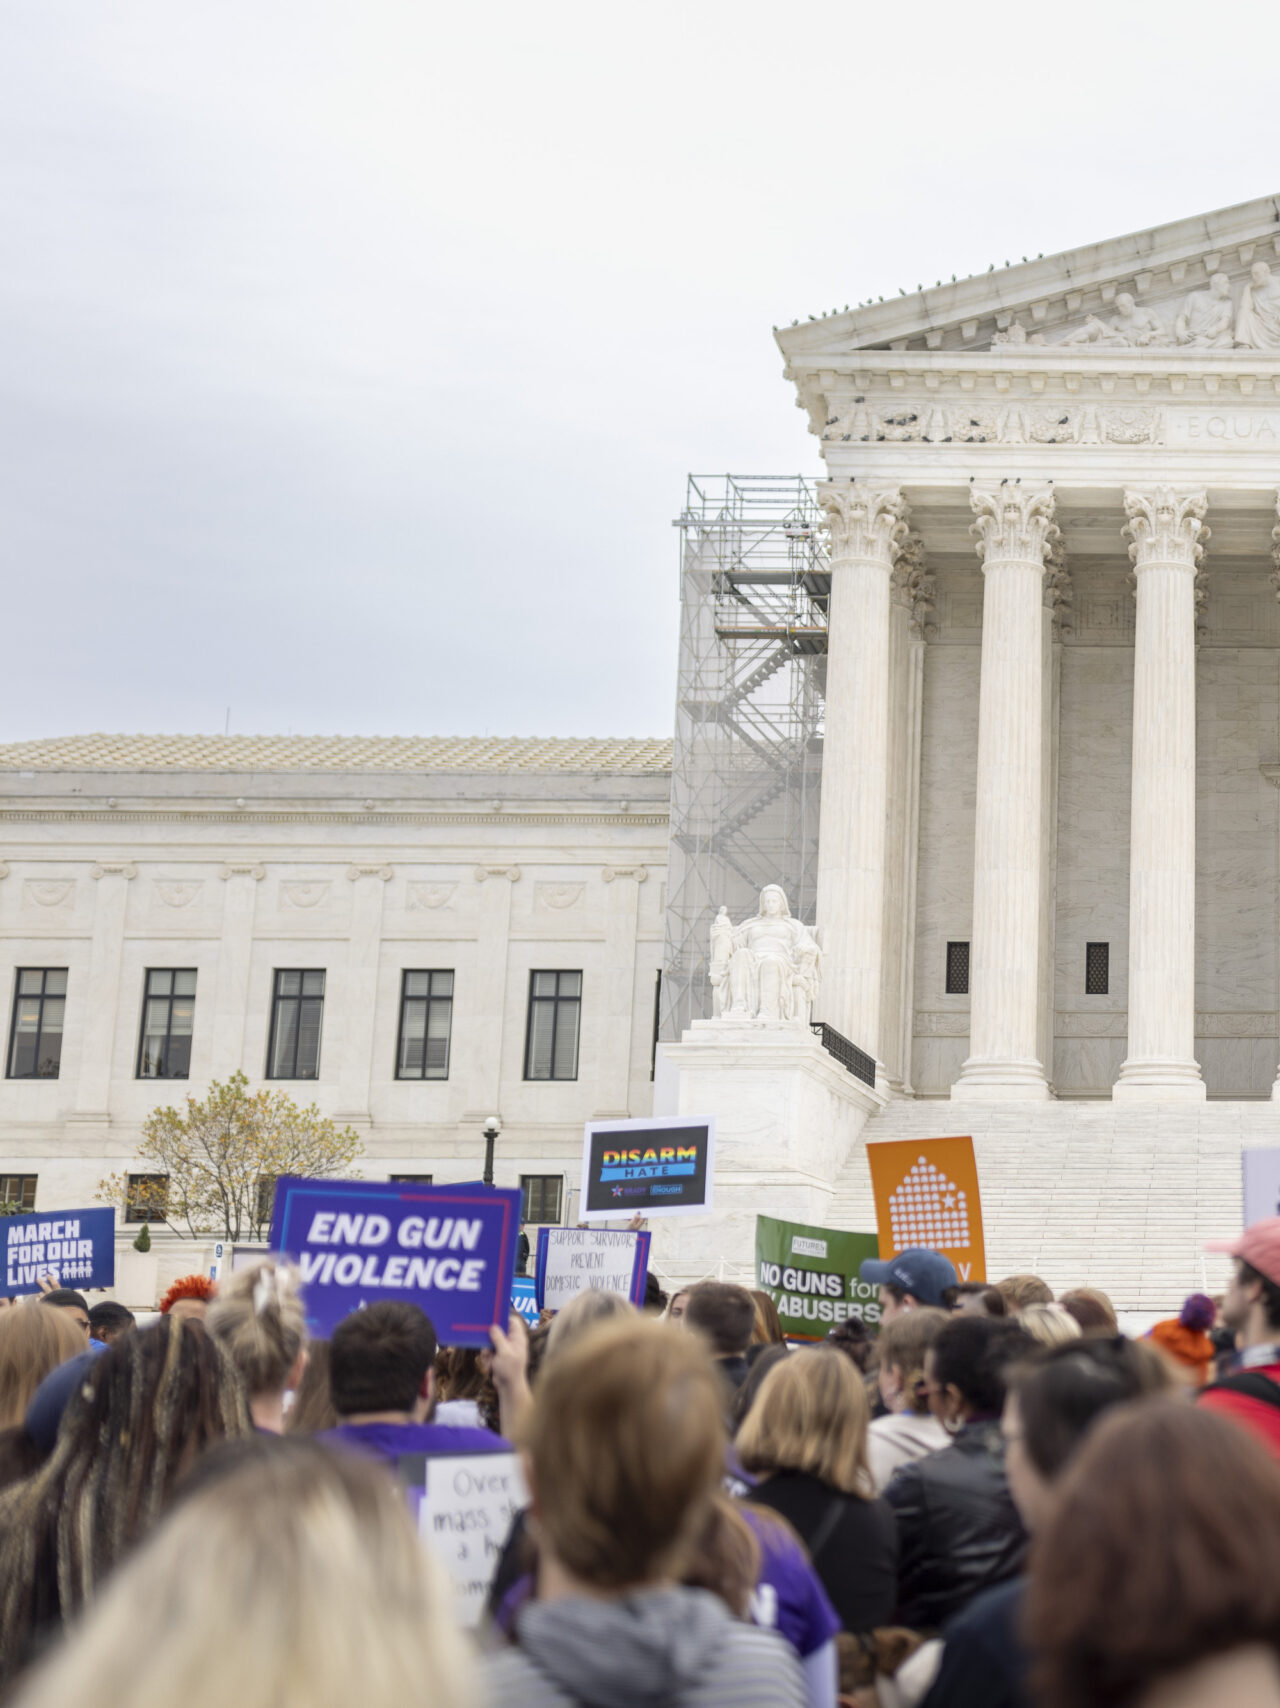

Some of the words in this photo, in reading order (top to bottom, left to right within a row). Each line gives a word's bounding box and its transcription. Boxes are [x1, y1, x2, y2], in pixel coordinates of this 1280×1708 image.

[603, 1146, 697, 1168] DISARM
[625, 1166, 669, 1178] HATE
[8, 1219, 80, 1245] MARCH
[306, 1211, 391, 1246] END
[397, 1216, 483, 1250] GUN
[550, 1231, 585, 1246] SUPPORT
[590, 1231, 635, 1248] SURVIVORS
[8, 1243, 45, 1266] FOR
[47, 1240, 93, 1260] OUR
[571, 1252, 605, 1269] PREVENT
[7, 1262, 60, 1286] LIVES
[299, 1252, 486, 1291] VIOLENCE
[546, 1275, 581, 1291] DOMESTIC
[589, 1273, 632, 1291] VIOLENCE
[760, 1262, 781, 1287] NO
[783, 1267, 843, 1297] GUNS
[849, 1277, 879, 1299] for
[777, 1294, 880, 1323] ABUSERS
[453, 1468, 510, 1497] Over
[433, 1508, 489, 1533] mass
